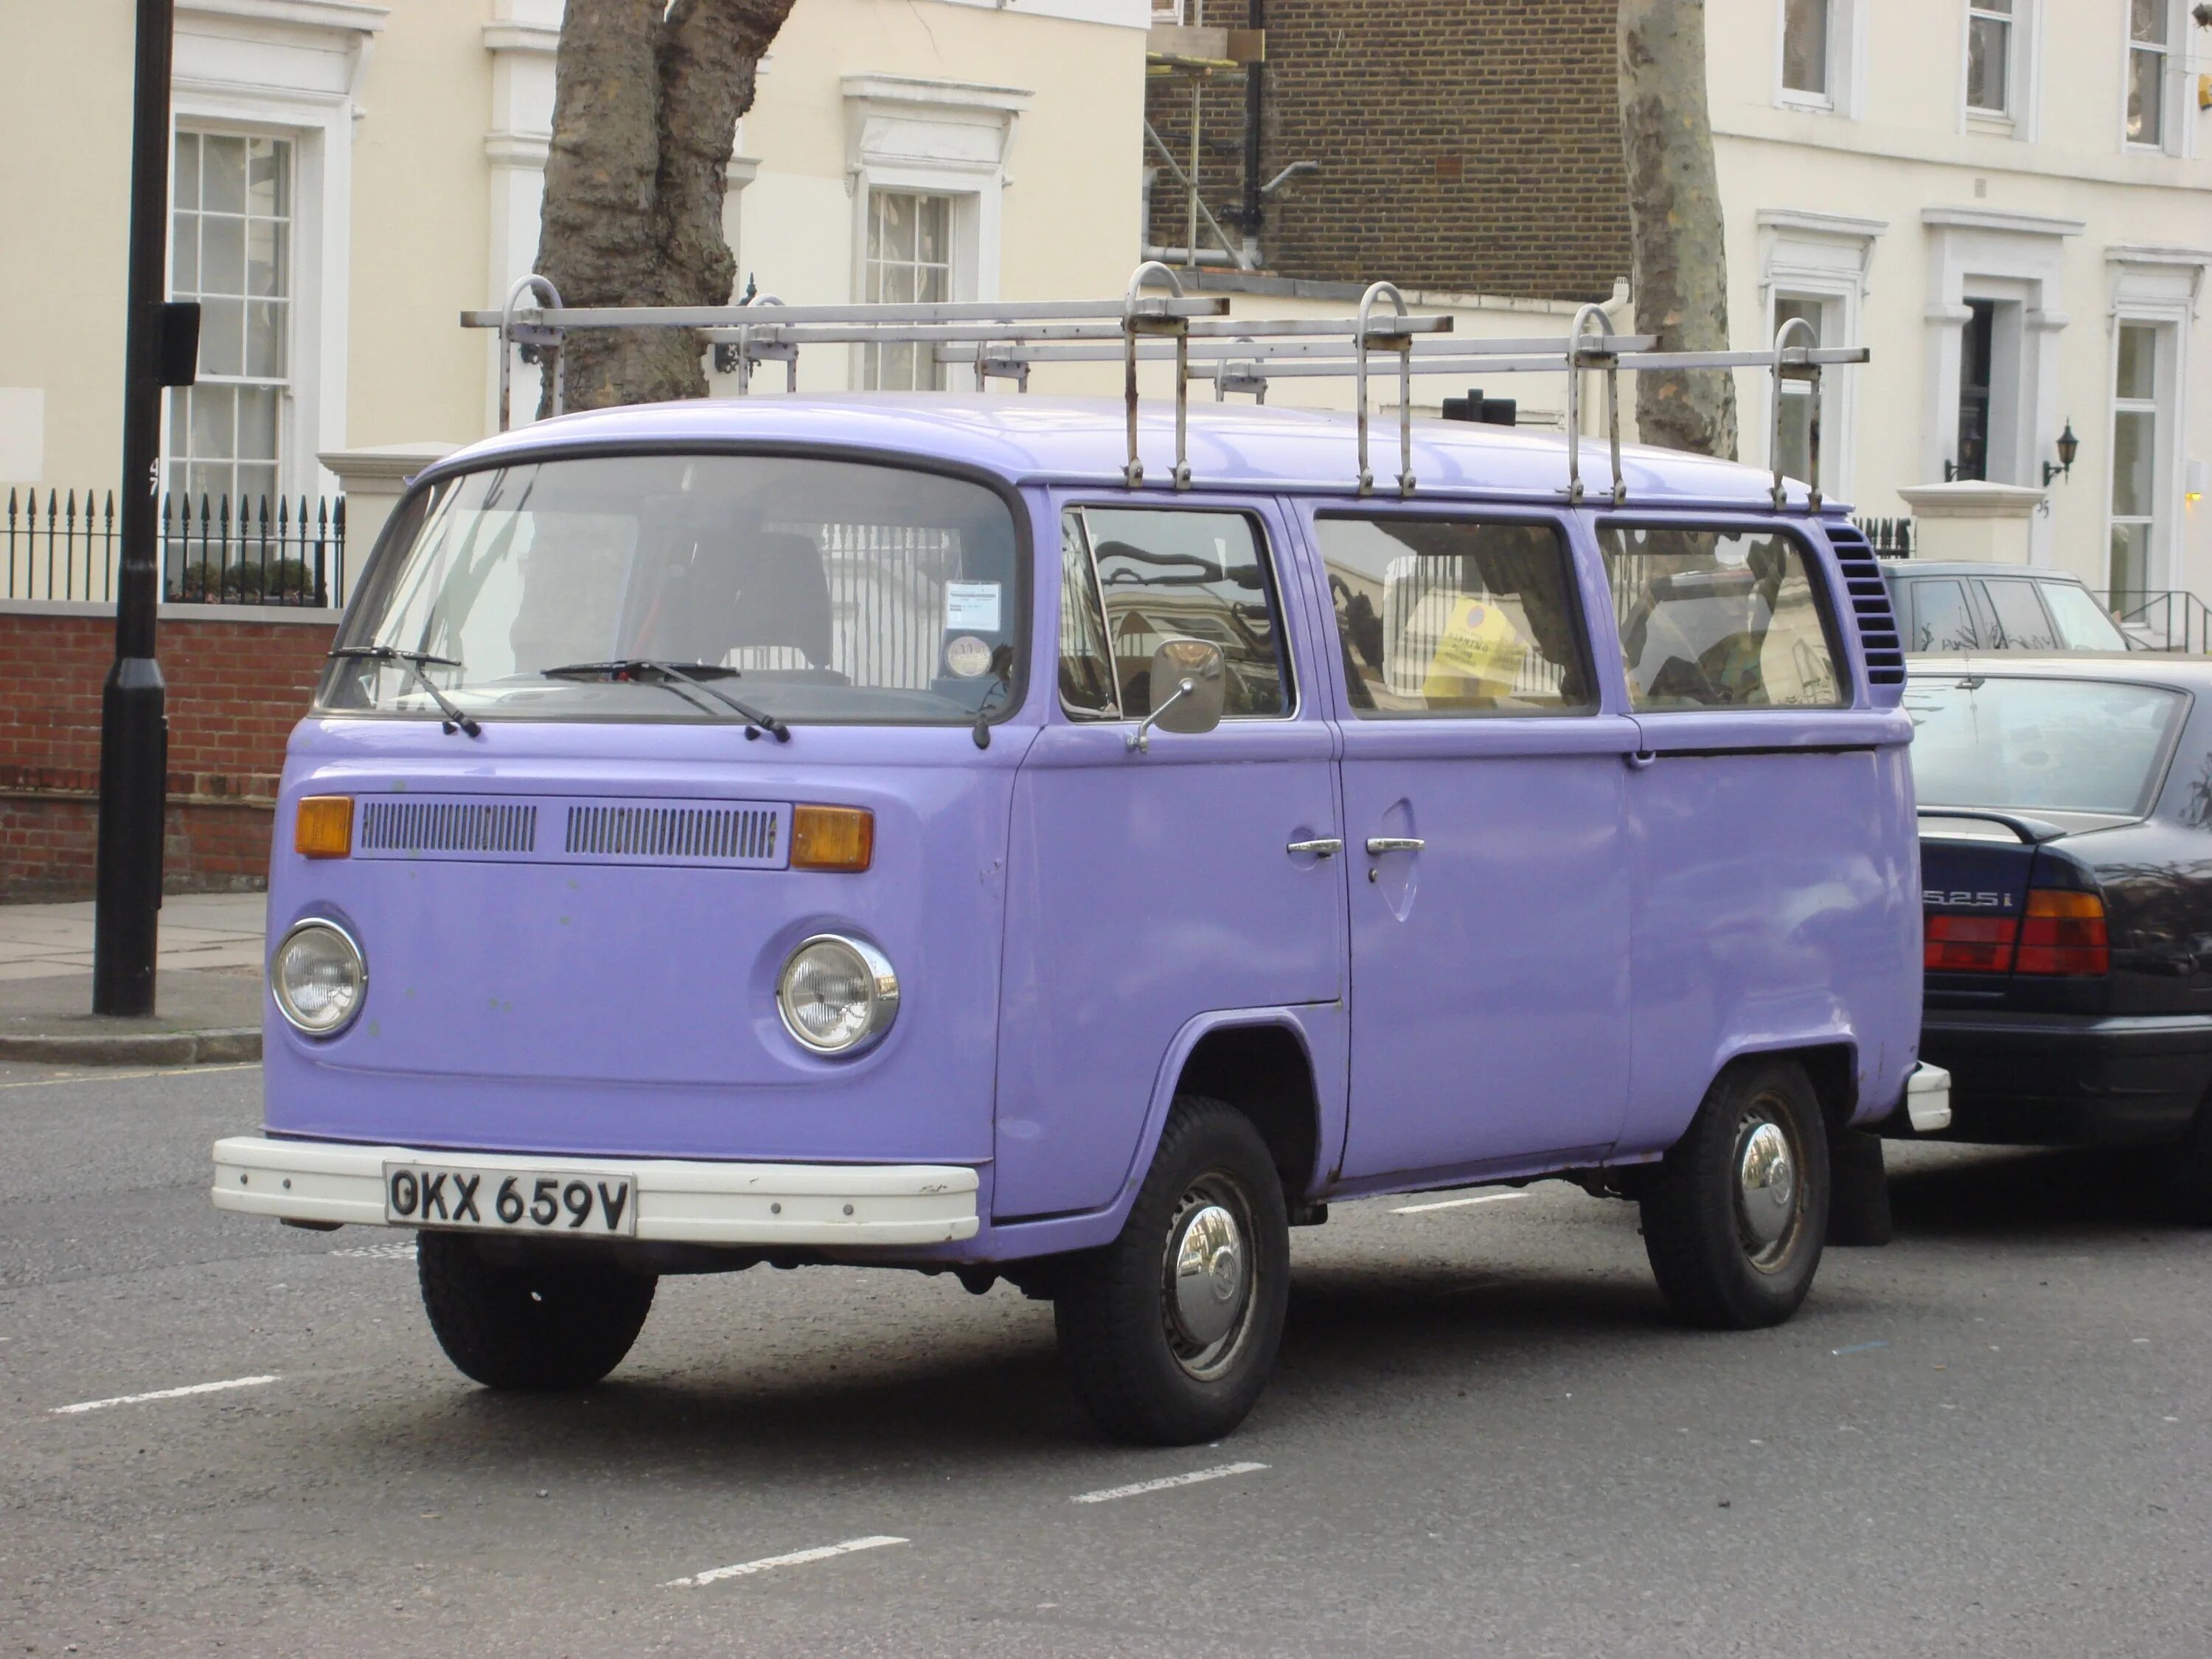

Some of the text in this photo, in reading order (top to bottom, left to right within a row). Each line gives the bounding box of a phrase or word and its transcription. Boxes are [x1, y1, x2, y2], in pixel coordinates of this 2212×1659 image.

[1922, 890, 2013, 907] 525i
[391, 1169, 628, 1230] OKX 659V
